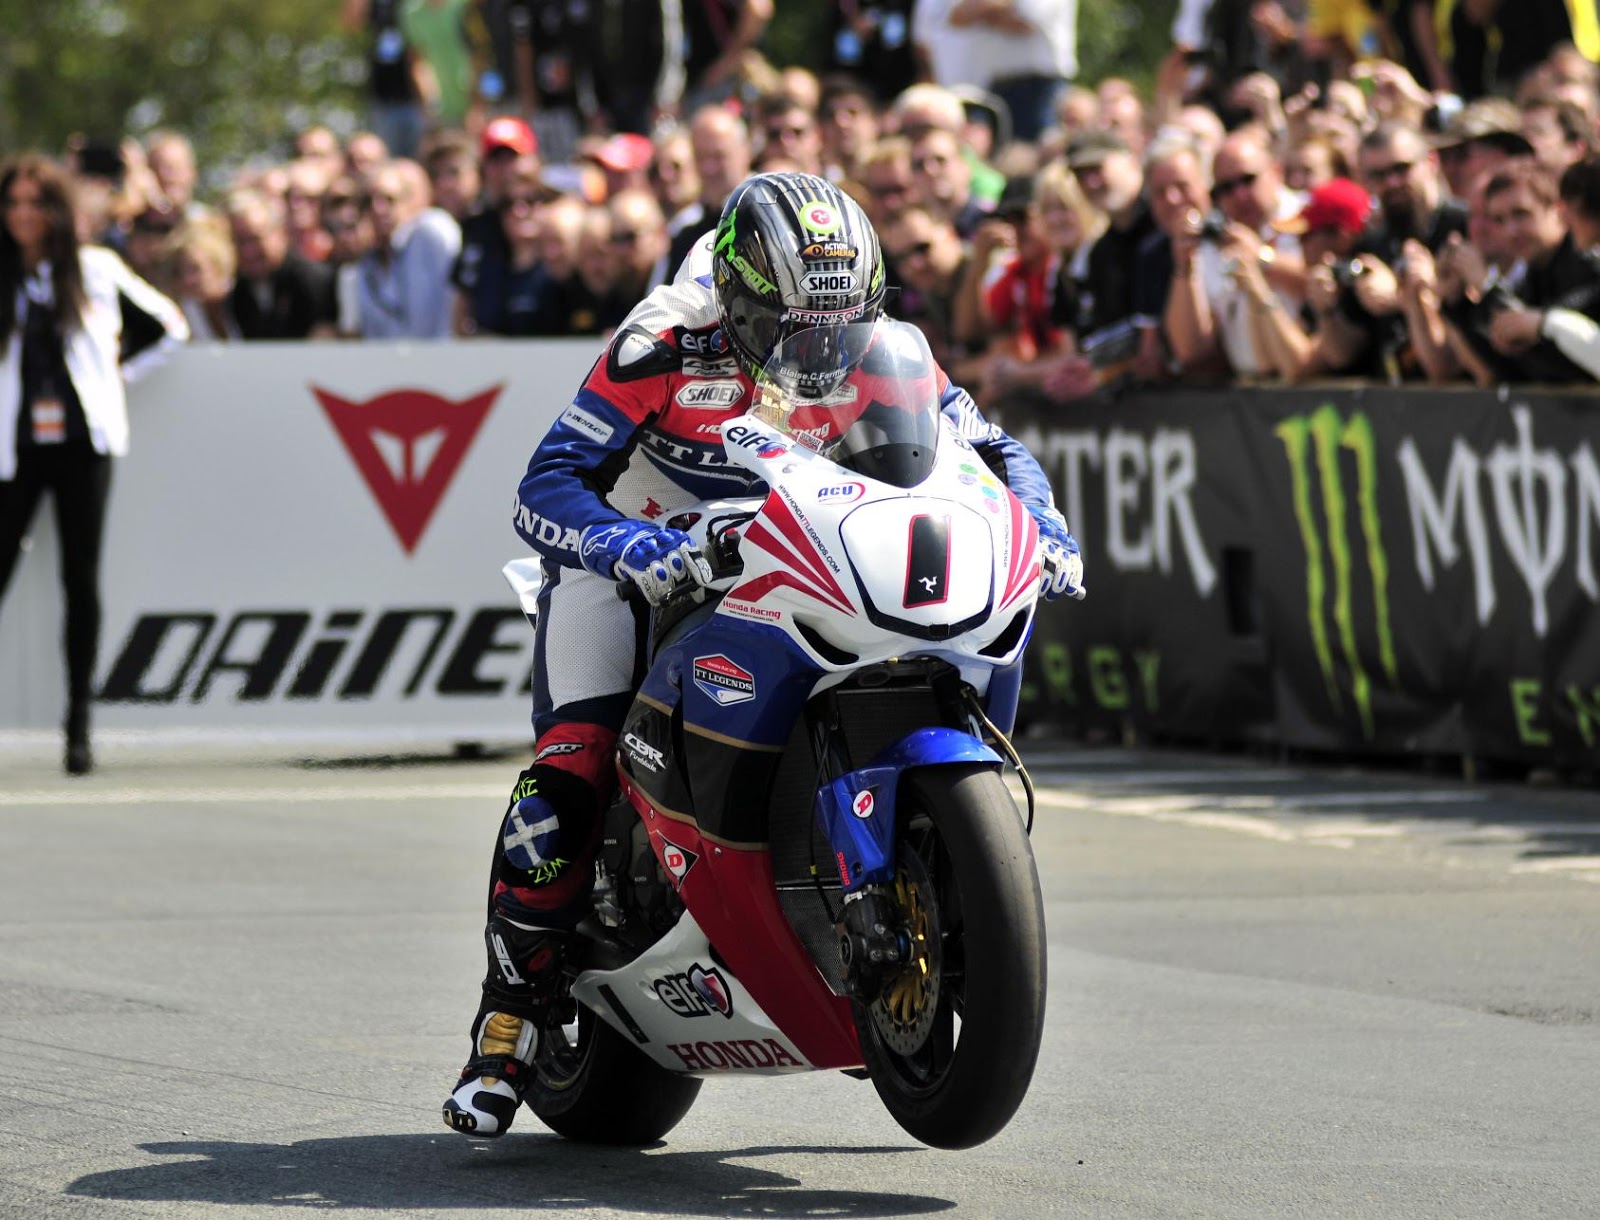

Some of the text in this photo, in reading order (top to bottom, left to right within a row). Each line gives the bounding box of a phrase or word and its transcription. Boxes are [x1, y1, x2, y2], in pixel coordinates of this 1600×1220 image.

[808, 275, 851, 291] SHOEI
[789, 307, 863, 323] DENNISON
[687, 386, 738, 403] SHOEI
[572, 413, 608, 436] DUNLOP
[726, 425, 771, 449] elf
[722, 600, 749, 613] Honda
[750, 606, 782, 620] Racing
[98, 607, 533, 702] DAINE
[708, 672, 753, 691] LEGENDS
[1019, 643, 1162, 714] RGY
[624, 732, 666, 769] CBR
[836, 851, 851, 888] SHOWA
[653, 974, 707, 1018] elf
[666, 1038, 804, 1071] HONDA
